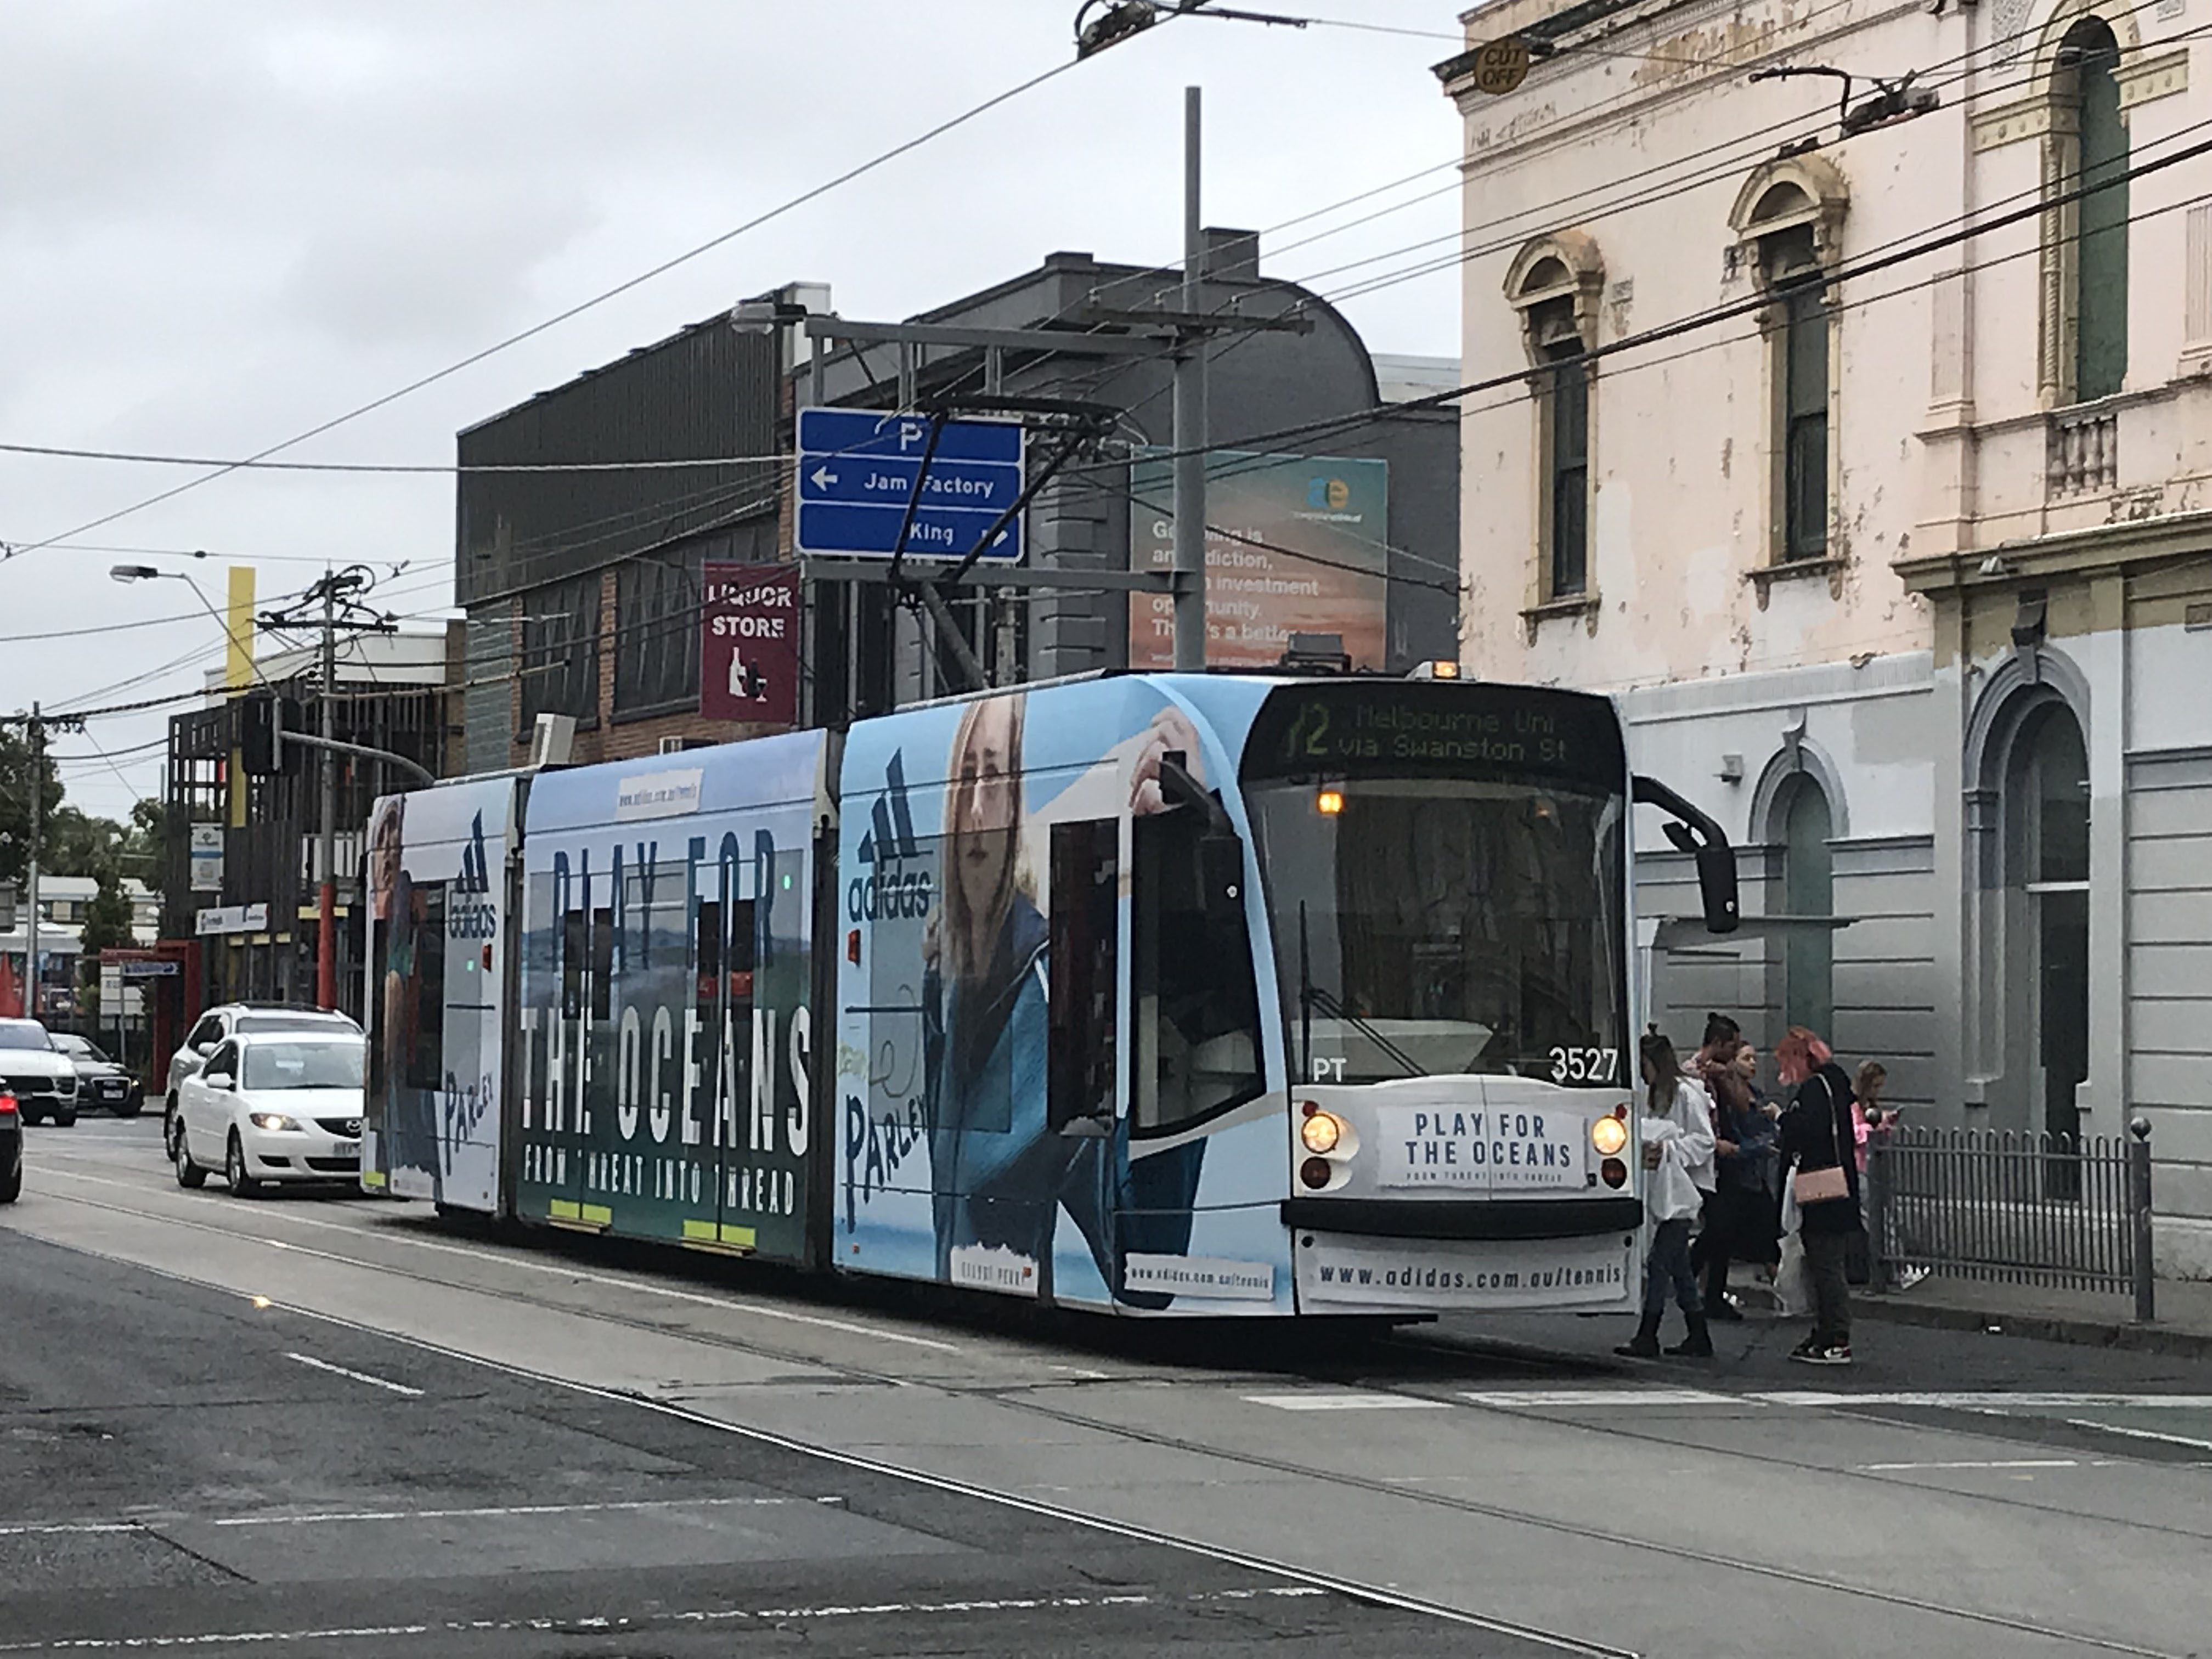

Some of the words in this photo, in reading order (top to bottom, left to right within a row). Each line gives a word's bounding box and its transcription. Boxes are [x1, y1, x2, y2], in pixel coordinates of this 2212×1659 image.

[1485, 48, 1521, 65] CUT
[1482, 67, 1519, 86] OFF
[900, 422, 923, 450] P
[864, 473, 907, 490] Jam
[910, 522, 953, 545] King
[708, 584, 792, 607] LIQUOR
[1217, 575, 1319, 596] investment
[712, 615, 785, 639] STORE
[1393, 735, 1525, 761] Swanston
[848, 859, 931, 922] adidas
[1313, 1057, 1347, 1082] PT
[1549, 1047, 1618, 1081] 3527
[520, 1007, 593, 1134] THE
[618, 1006, 811, 1156] OCEANS
[1415, 1113, 1483, 1136] PLAY
[1500, 1115, 1544, 1137] FOR
[1406, 1142, 1457, 1165] THE
[1473, 1143, 1571, 1167] OCEANS
[655, 1158, 701, 1204] INTO
[1319, 1263, 1621, 1288] www.adidas.com.au/tennis
